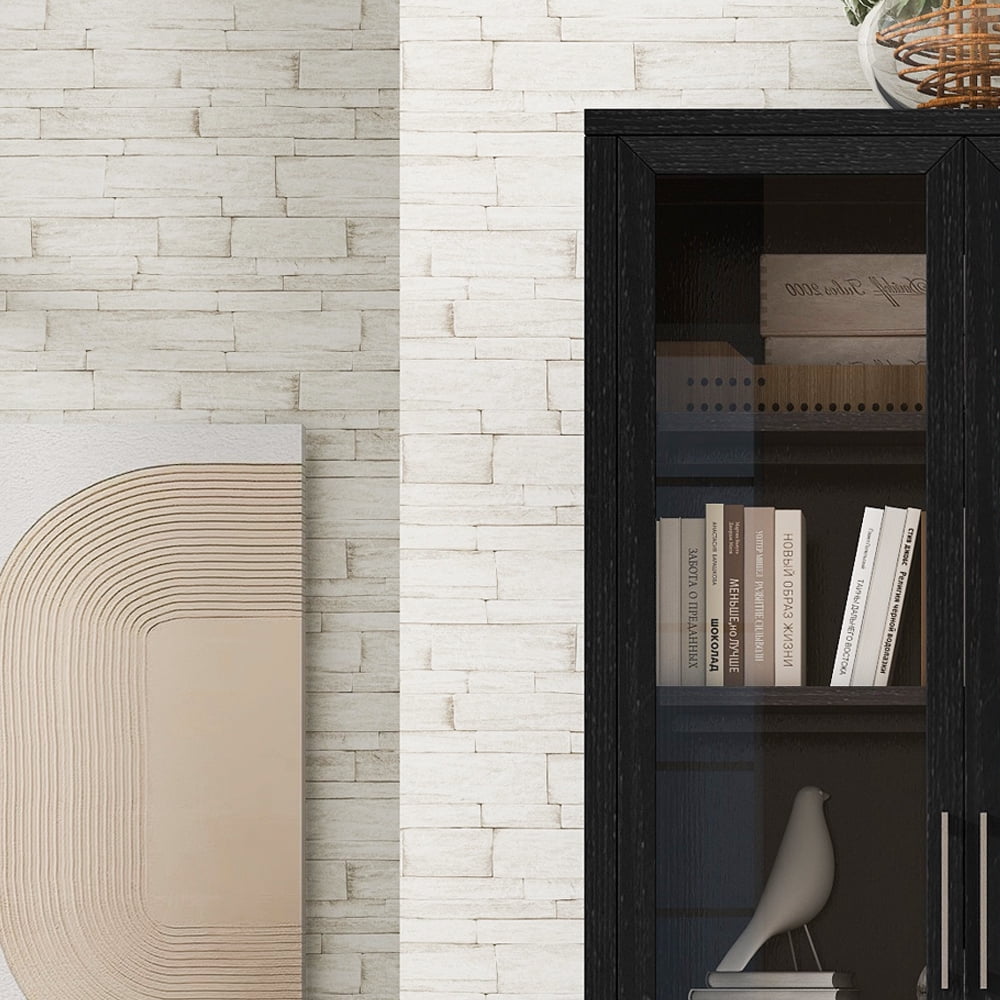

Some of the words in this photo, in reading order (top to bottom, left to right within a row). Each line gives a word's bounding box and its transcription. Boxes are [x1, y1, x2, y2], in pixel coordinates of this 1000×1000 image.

[688, 548, 698, 588] ЗАБОТА
[783, 533, 795, 577] НОВЫЙ
[688, 591, 698, 599] О
[783, 581, 794, 619] ОБРАЗ
[893, 571, 907, 603] Религия
[687, 601, 698, 669] ПРЕДАННЫХ
[887, 604, 899, 632] черной
[709, 618, 719, 672] ШОКОЛАД
[728, 637, 740, 673] ЛУЧШЕ
[783, 623, 794, 668] ЖИЗНИ
[880, 633, 893, 674] водолазки
